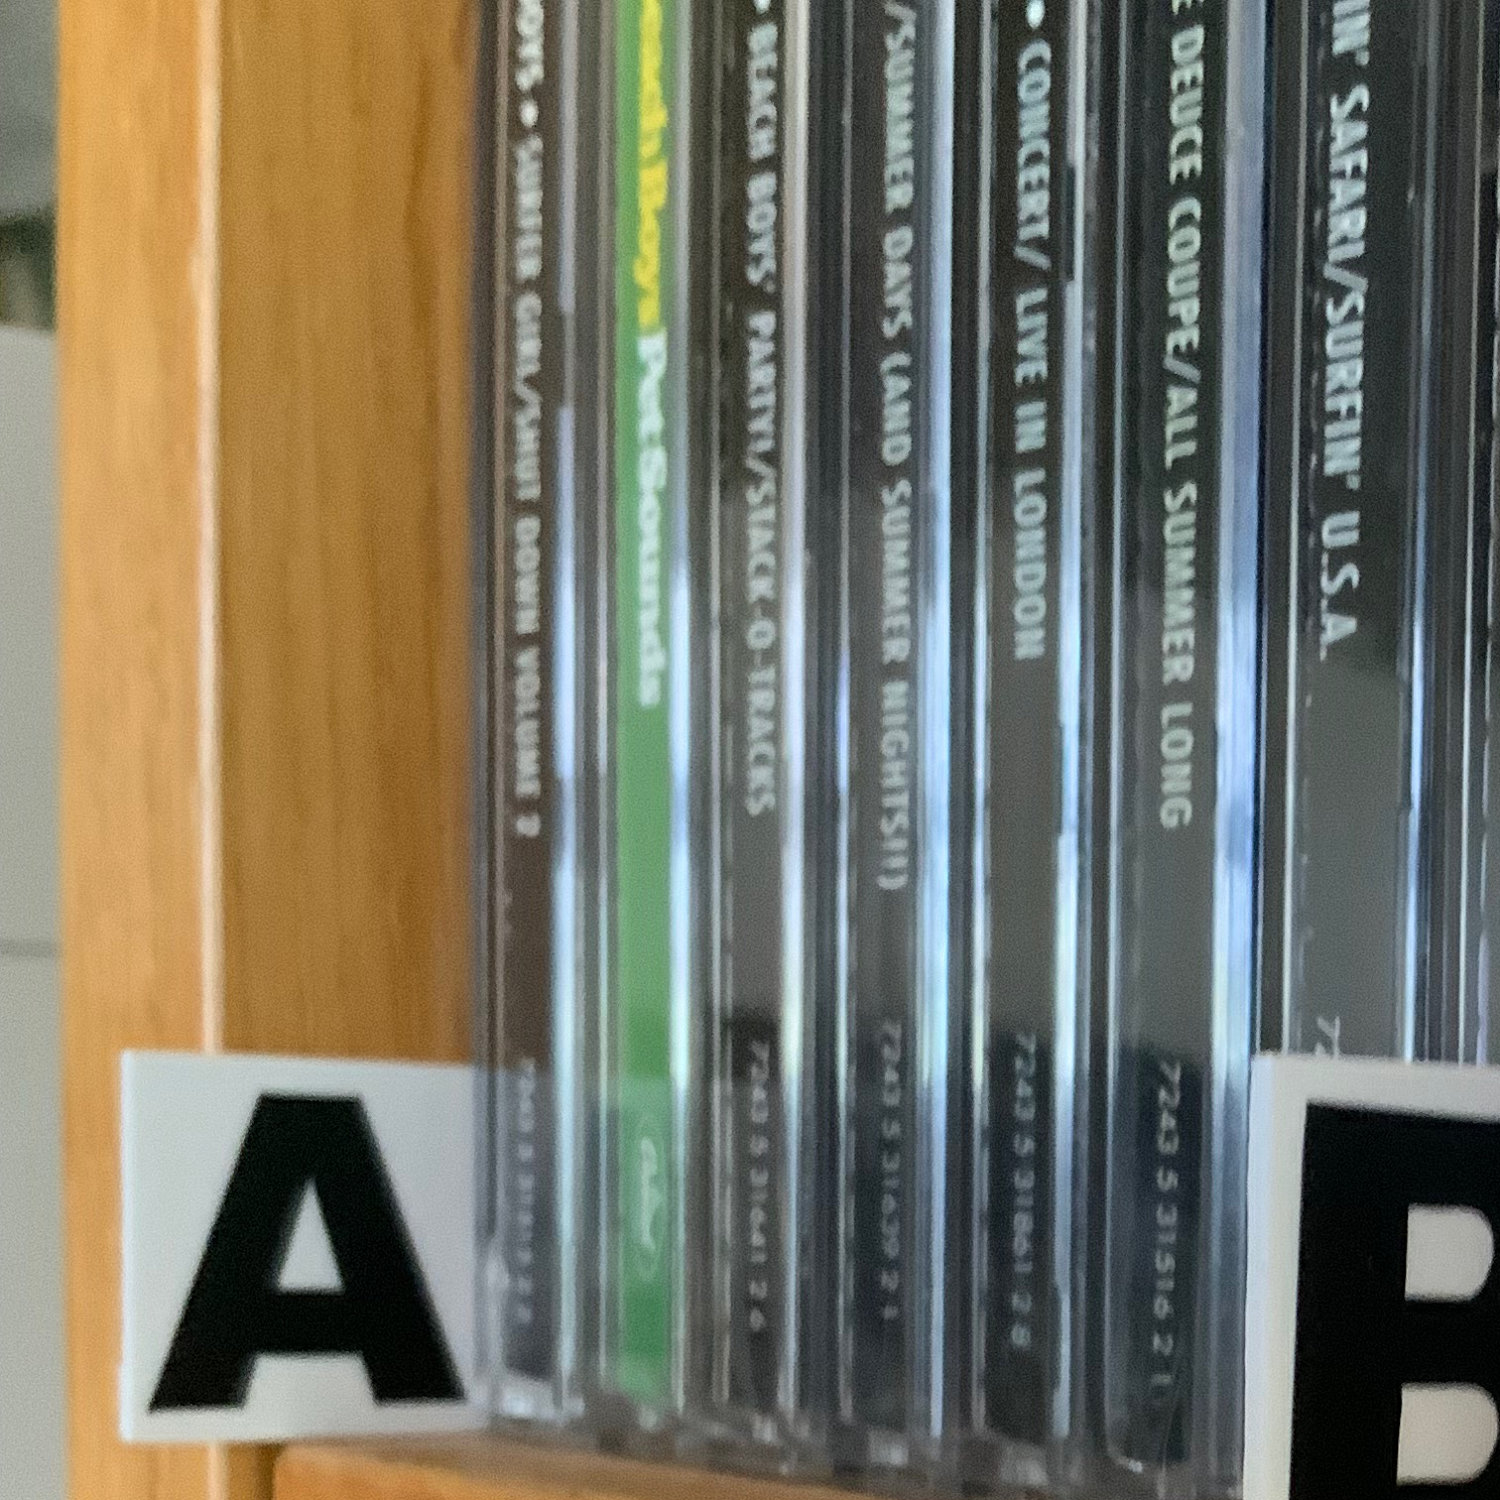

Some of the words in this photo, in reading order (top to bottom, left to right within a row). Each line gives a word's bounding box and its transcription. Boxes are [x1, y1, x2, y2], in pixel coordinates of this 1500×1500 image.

[746, 21, 779, 162] BEACH
[1168, 23, 1206, 187] DEUCE
[880, 224, 914, 340] DAYS
[1012, 285, 1050, 387] LIVE
[1012, 398, 1048, 455] IN
[879, 478, 913, 666] SUMMER
[1012, 465, 1048, 662] LONDON
[1161, 479, 1198, 687] SUMMER
[1159, 700, 1195, 831] LONG
[1012, 1032, 1037, 1122] 7243
[1157, 1059, 1182, 1155] 7243
[1156, 1165, 1180, 1192] 5
[149, 1093, 468, 1414] A
[1151, 1330, 1175, 1356] 2
